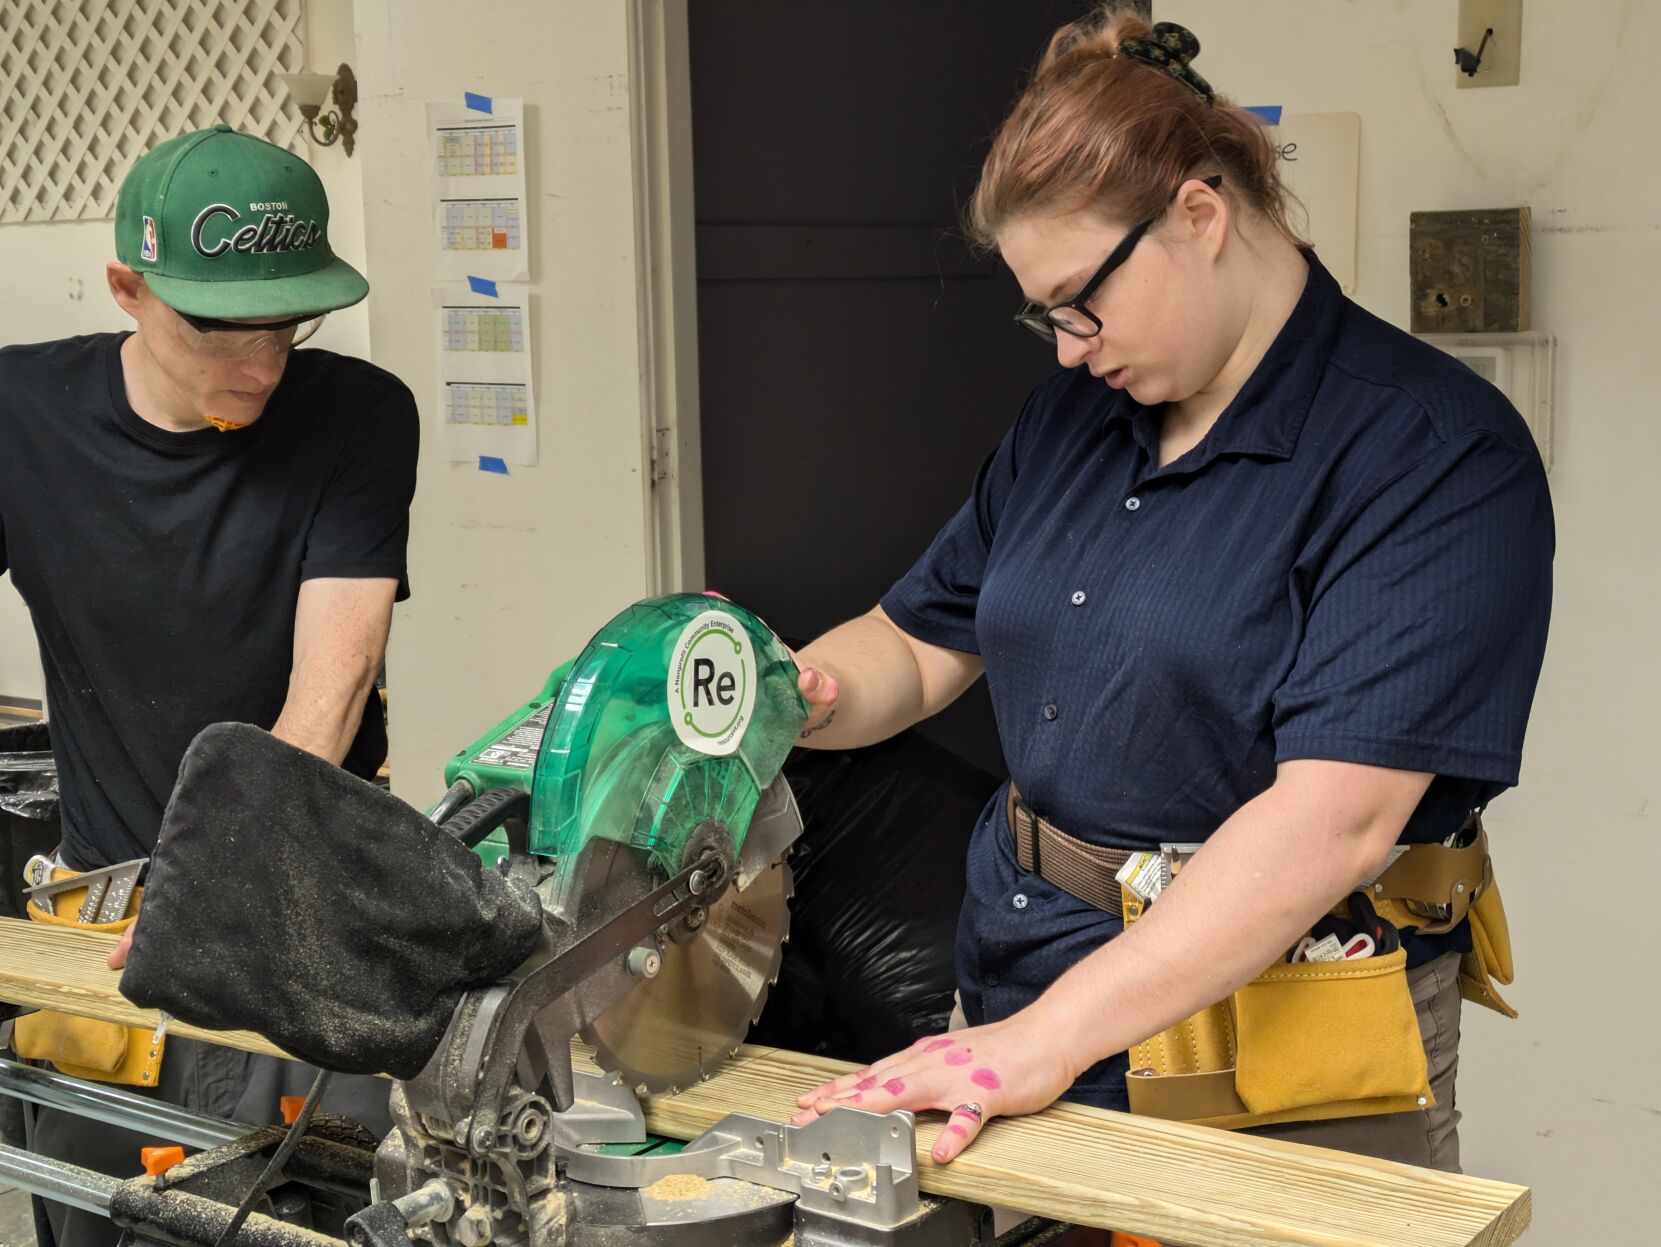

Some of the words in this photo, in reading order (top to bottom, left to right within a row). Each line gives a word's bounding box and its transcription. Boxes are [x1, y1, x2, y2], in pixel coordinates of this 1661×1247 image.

[192, 203, 321, 259] Celtics
[250, 202, 288, 212] BOSTON
[674, 649, 687, 686] Nonprofit
[684, 624, 709, 649] Community
[710, 620, 734, 633] Enterprise
[692, 658, 736, 707] Re
